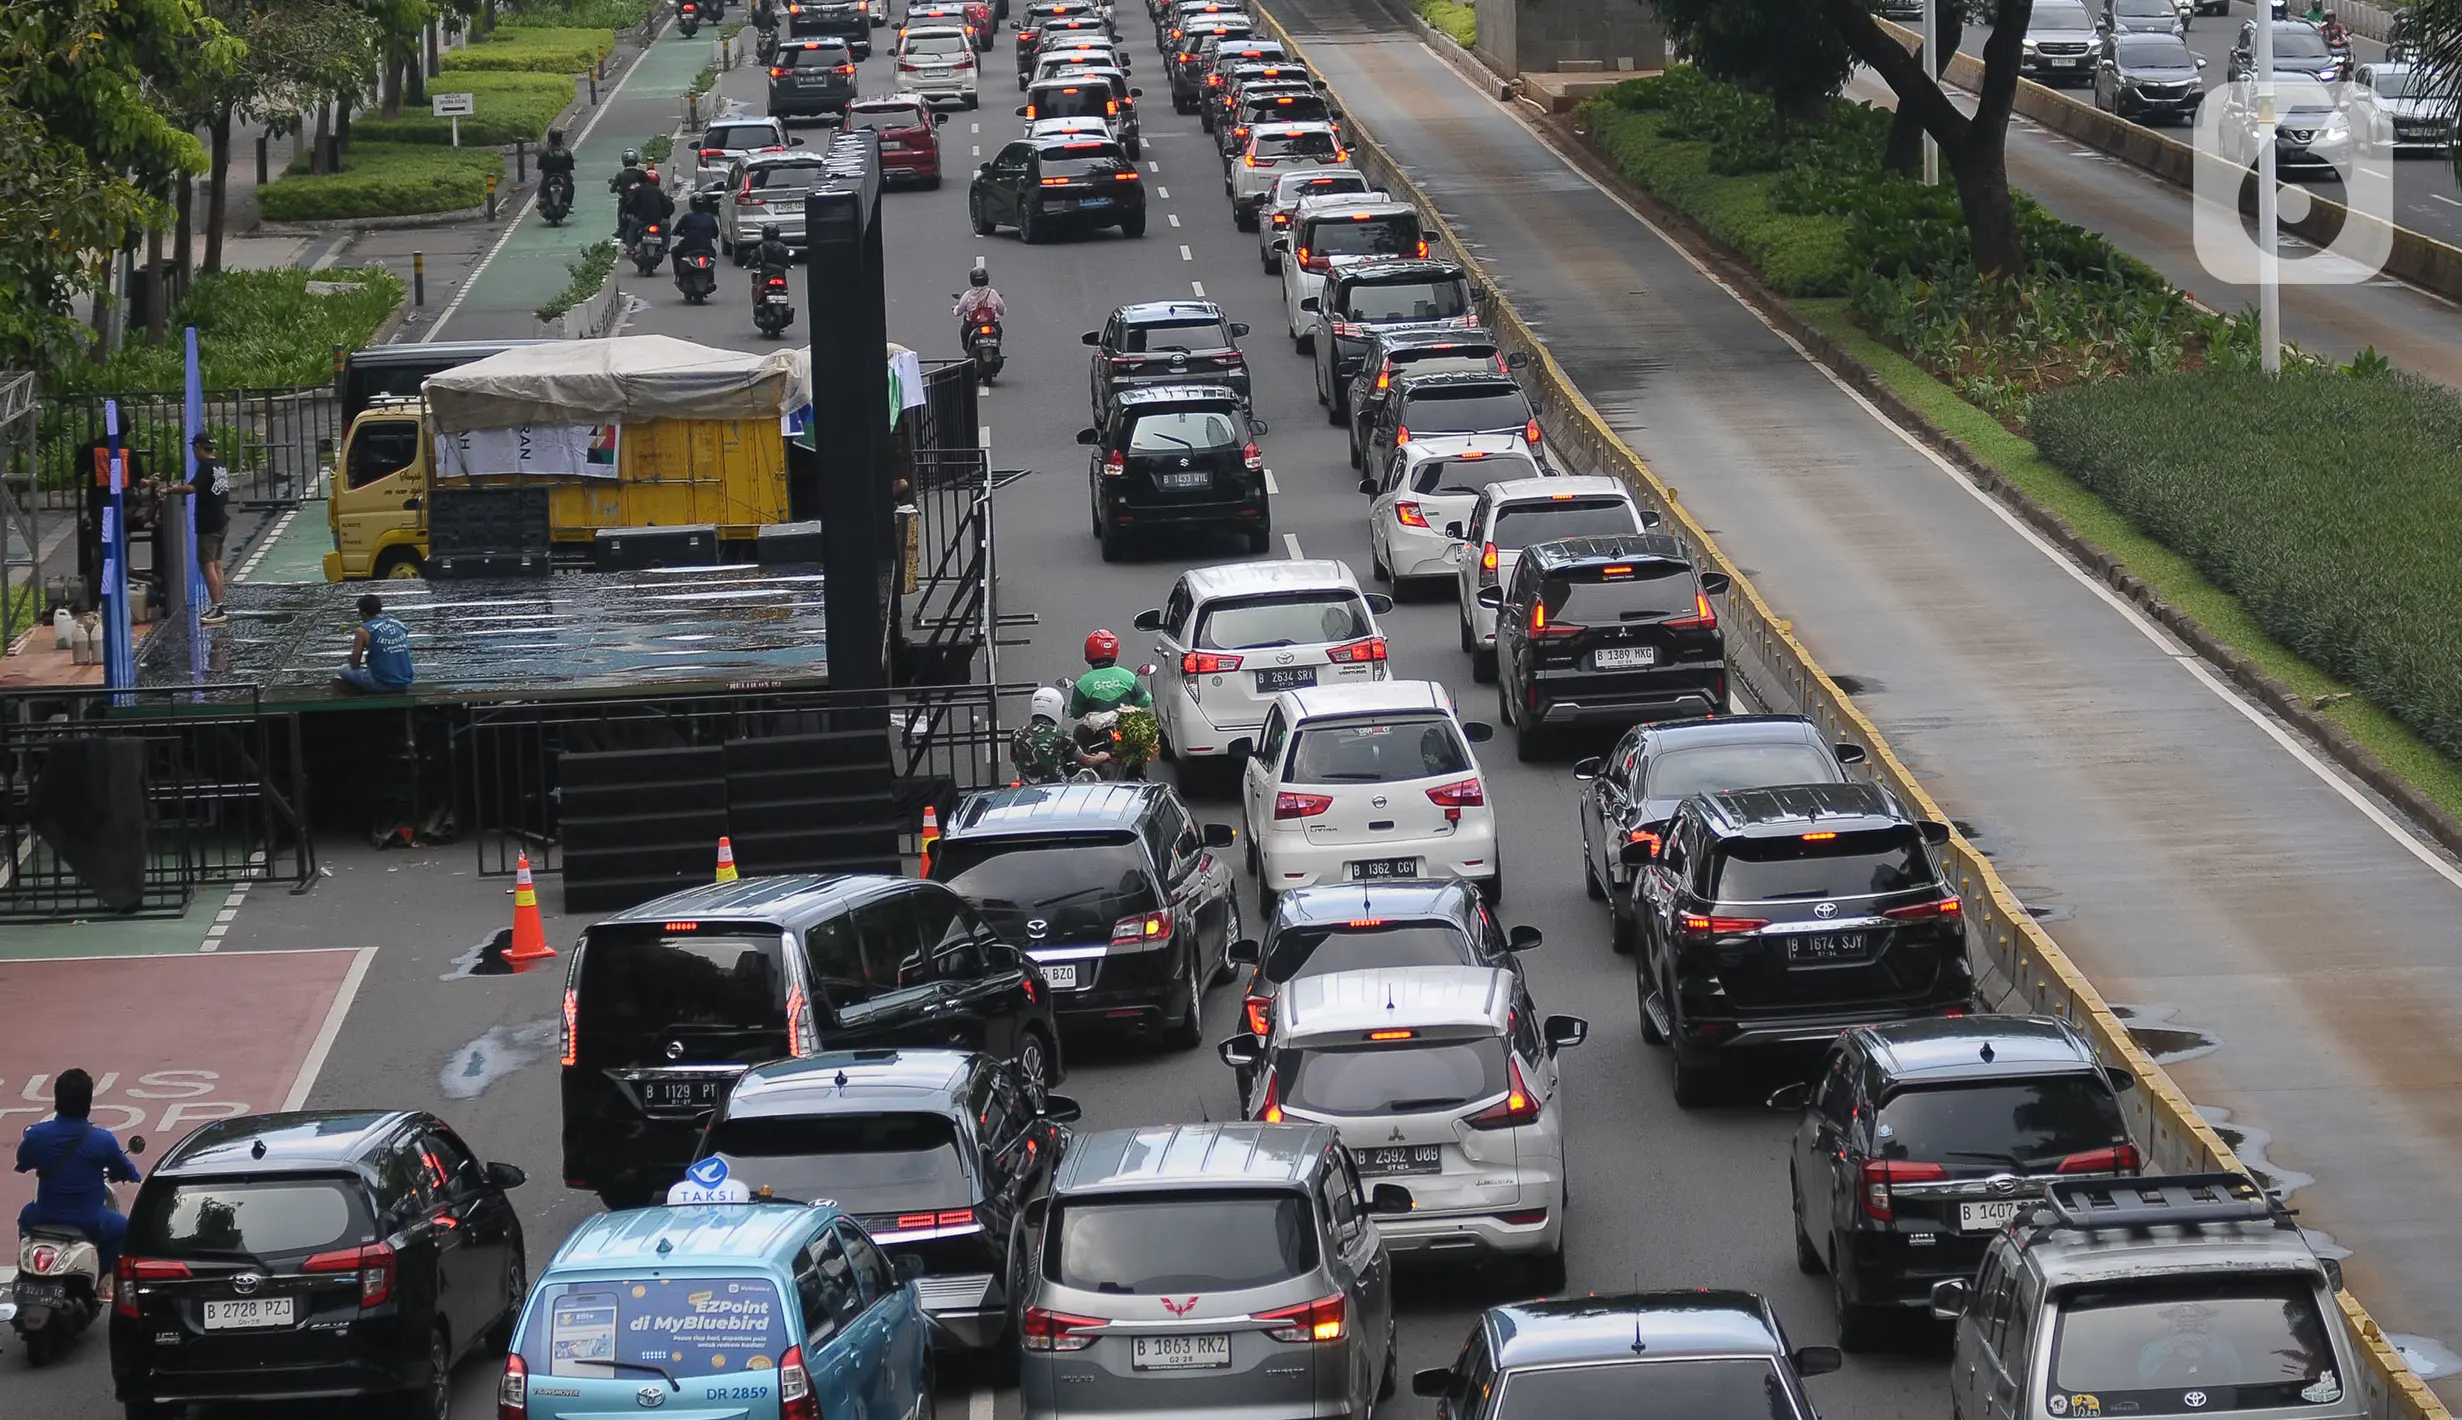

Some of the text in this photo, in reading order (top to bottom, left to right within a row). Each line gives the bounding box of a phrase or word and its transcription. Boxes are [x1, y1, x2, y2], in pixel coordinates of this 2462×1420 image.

[1598, 648, 1652, 661] B 1389 HKG
[1094, 676, 1120, 690] Grab
[1258, 668, 1314, 684] B 2634 SRX
[1353, 861, 1416, 876] B 1362 CGY
[1791, 934, 1863, 951] B 1674 SJY
[0, 1070, 220, 1101] US
[646, 1085, 654, 1099] B
[665, 1084, 690, 1098] 1129
[1358, 1152, 1366, 1164] B
[1375, 1149, 1407, 1163] 2592
[681, 1191, 735, 1202] TAKSI
[1963, 1207, 1971, 1220] B
[1980, 1203, 2014, 1219] 1407
[207, 1301, 291, 1319] B 2728 PZJ
[695, 1300, 769, 1314] EZPoint
[630, 1315, 770, 1333] di MyBluebird
[1137, 1336, 1226, 1356] B 1863 RKZ
[707, 1386, 768, 1400] DR 2859
